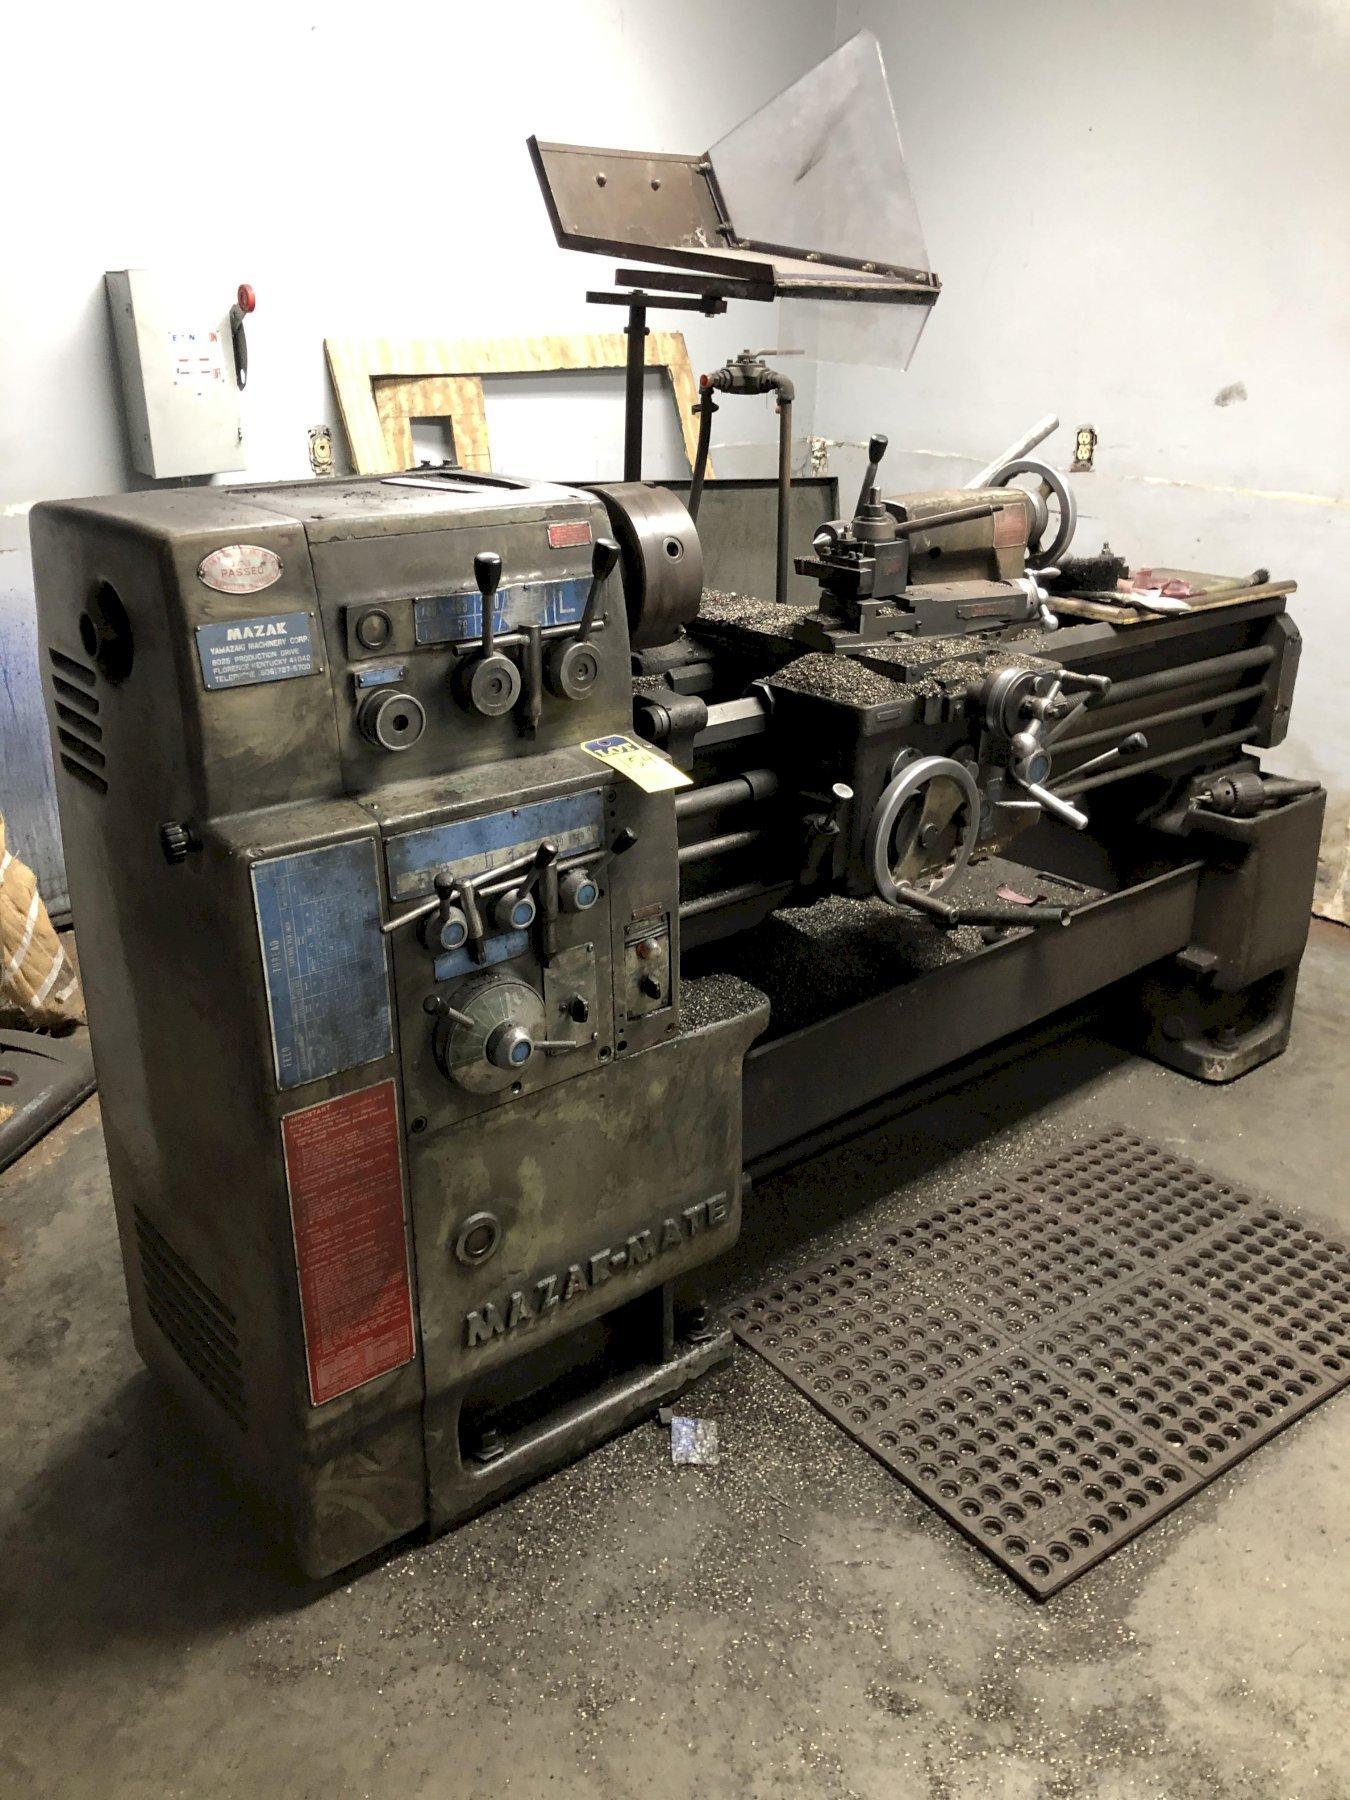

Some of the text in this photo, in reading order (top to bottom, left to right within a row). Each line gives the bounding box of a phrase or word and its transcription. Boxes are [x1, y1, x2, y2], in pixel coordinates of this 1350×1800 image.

[227, 622, 288, 641] MAZAK
[210, 644, 246, 655] YAMAZAKI
[248, 638, 287, 650] MACHINERY
[234, 651, 278, 663] PRODUCTION
[280, 648, 300, 657] DRIVE
[465, 1191, 728, 1347] MAZAK-MATE
